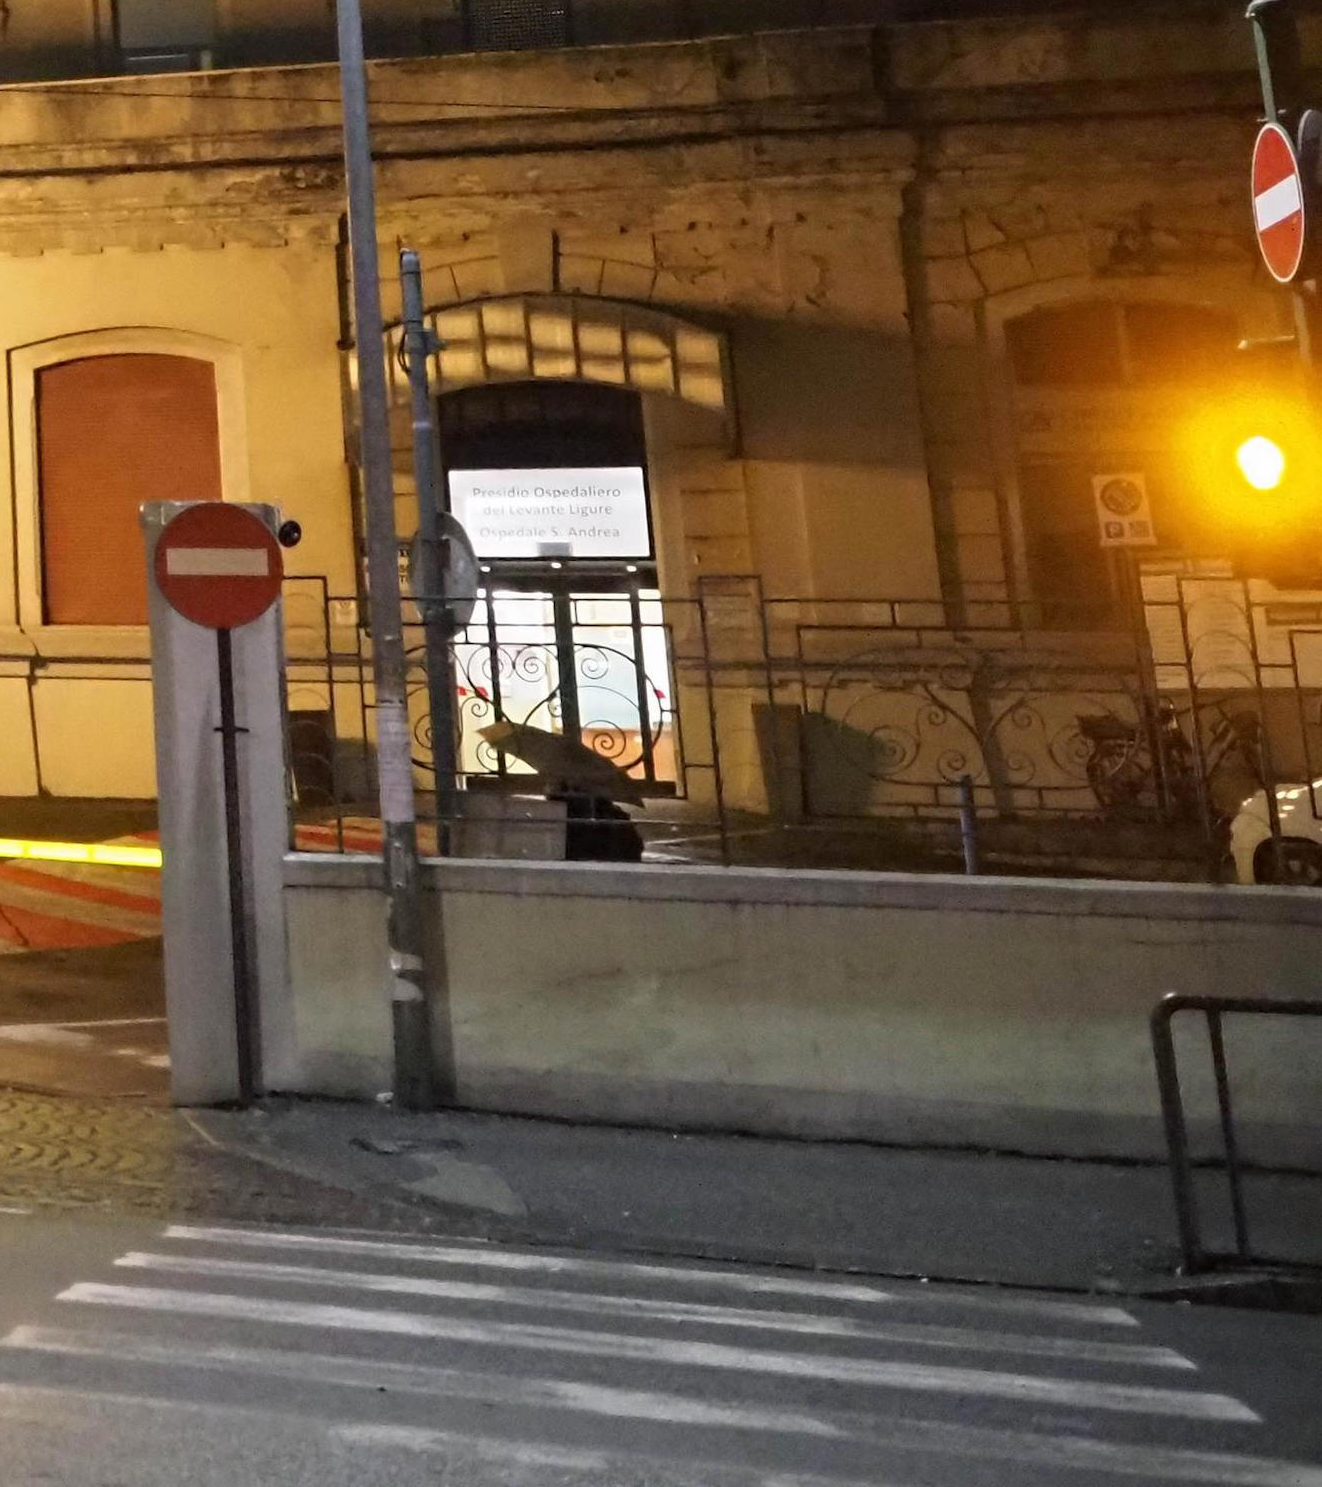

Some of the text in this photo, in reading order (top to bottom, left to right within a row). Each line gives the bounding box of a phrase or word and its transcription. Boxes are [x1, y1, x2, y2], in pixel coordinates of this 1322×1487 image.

[472, 486, 622, 499] Presidio Ospedaliero
[483, 503, 613, 517] del Levante Ligure
[479, 525, 621, 540] Ospedale S. Andrea
